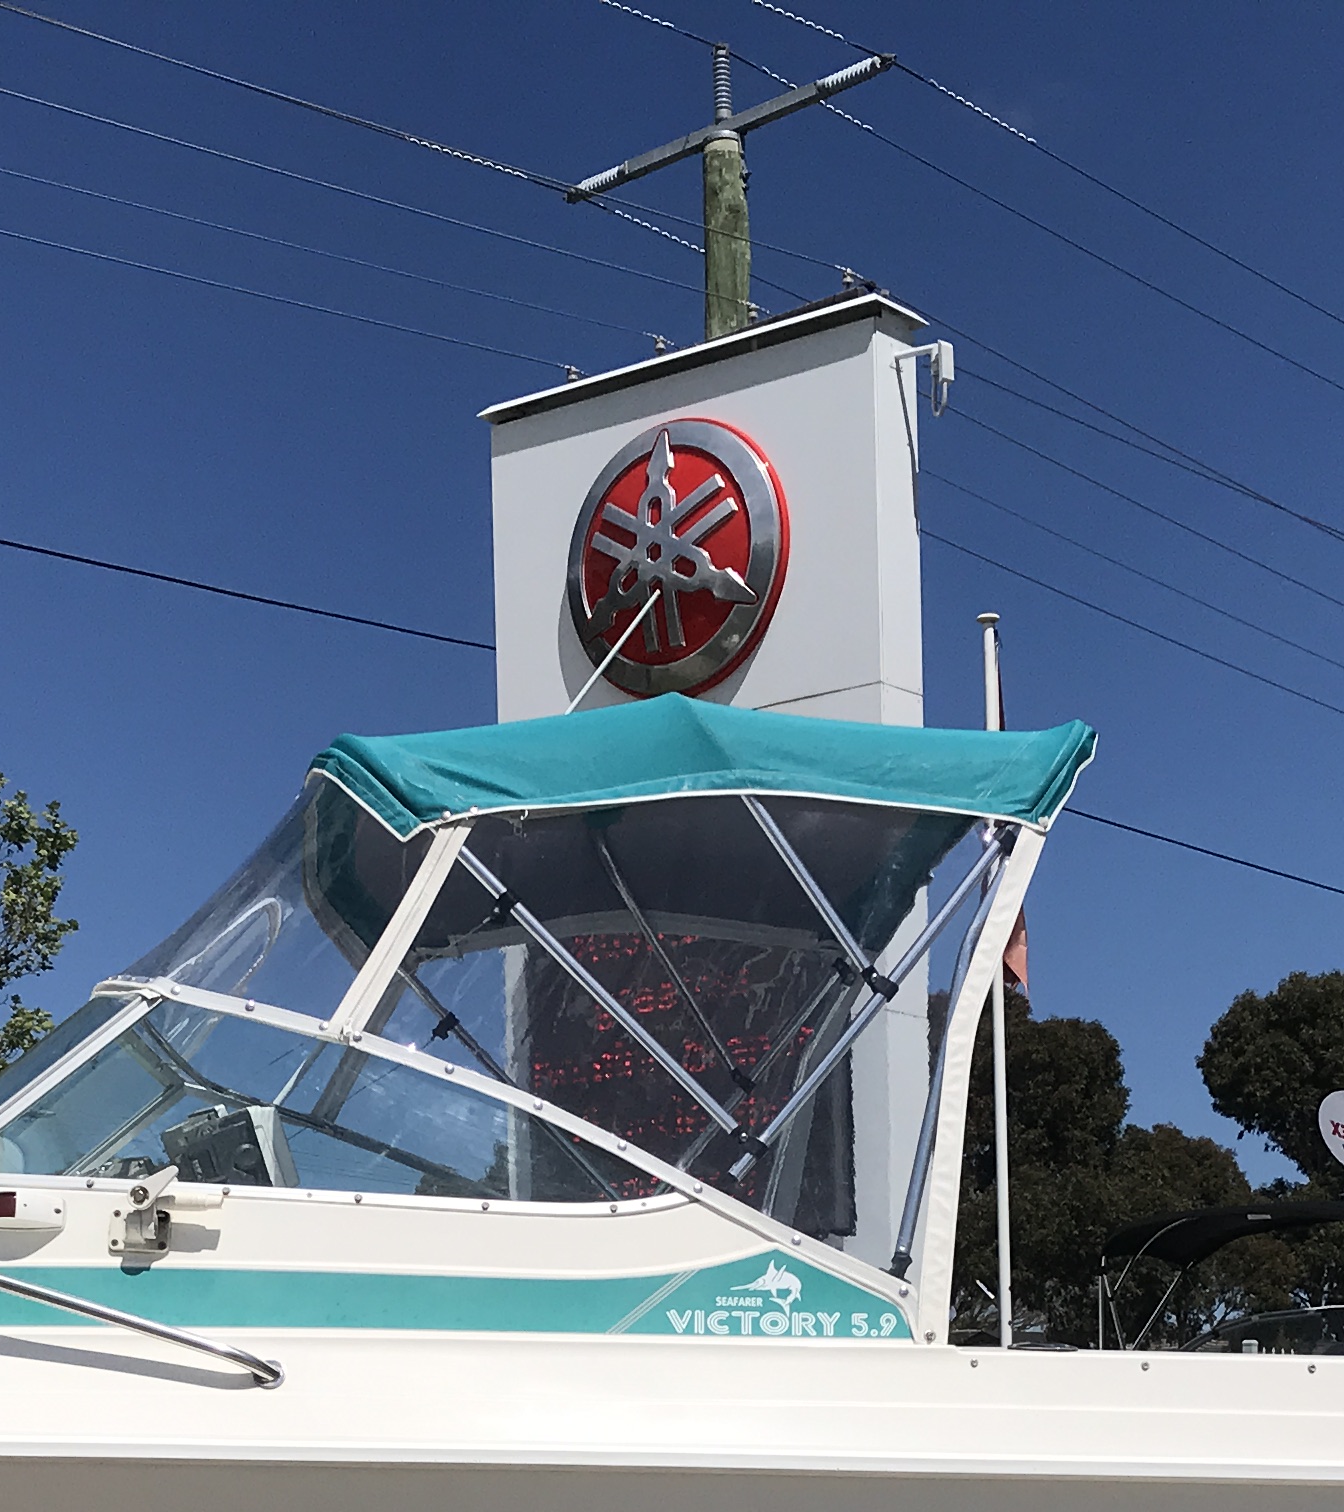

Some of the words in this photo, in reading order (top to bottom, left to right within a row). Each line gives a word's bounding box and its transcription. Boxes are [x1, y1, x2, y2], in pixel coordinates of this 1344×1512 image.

[715, 1296, 763, 1307] SEAFARER
[666, 1309, 840, 1336] VICTORY
[851, 1312, 897, 1337] 5.9
